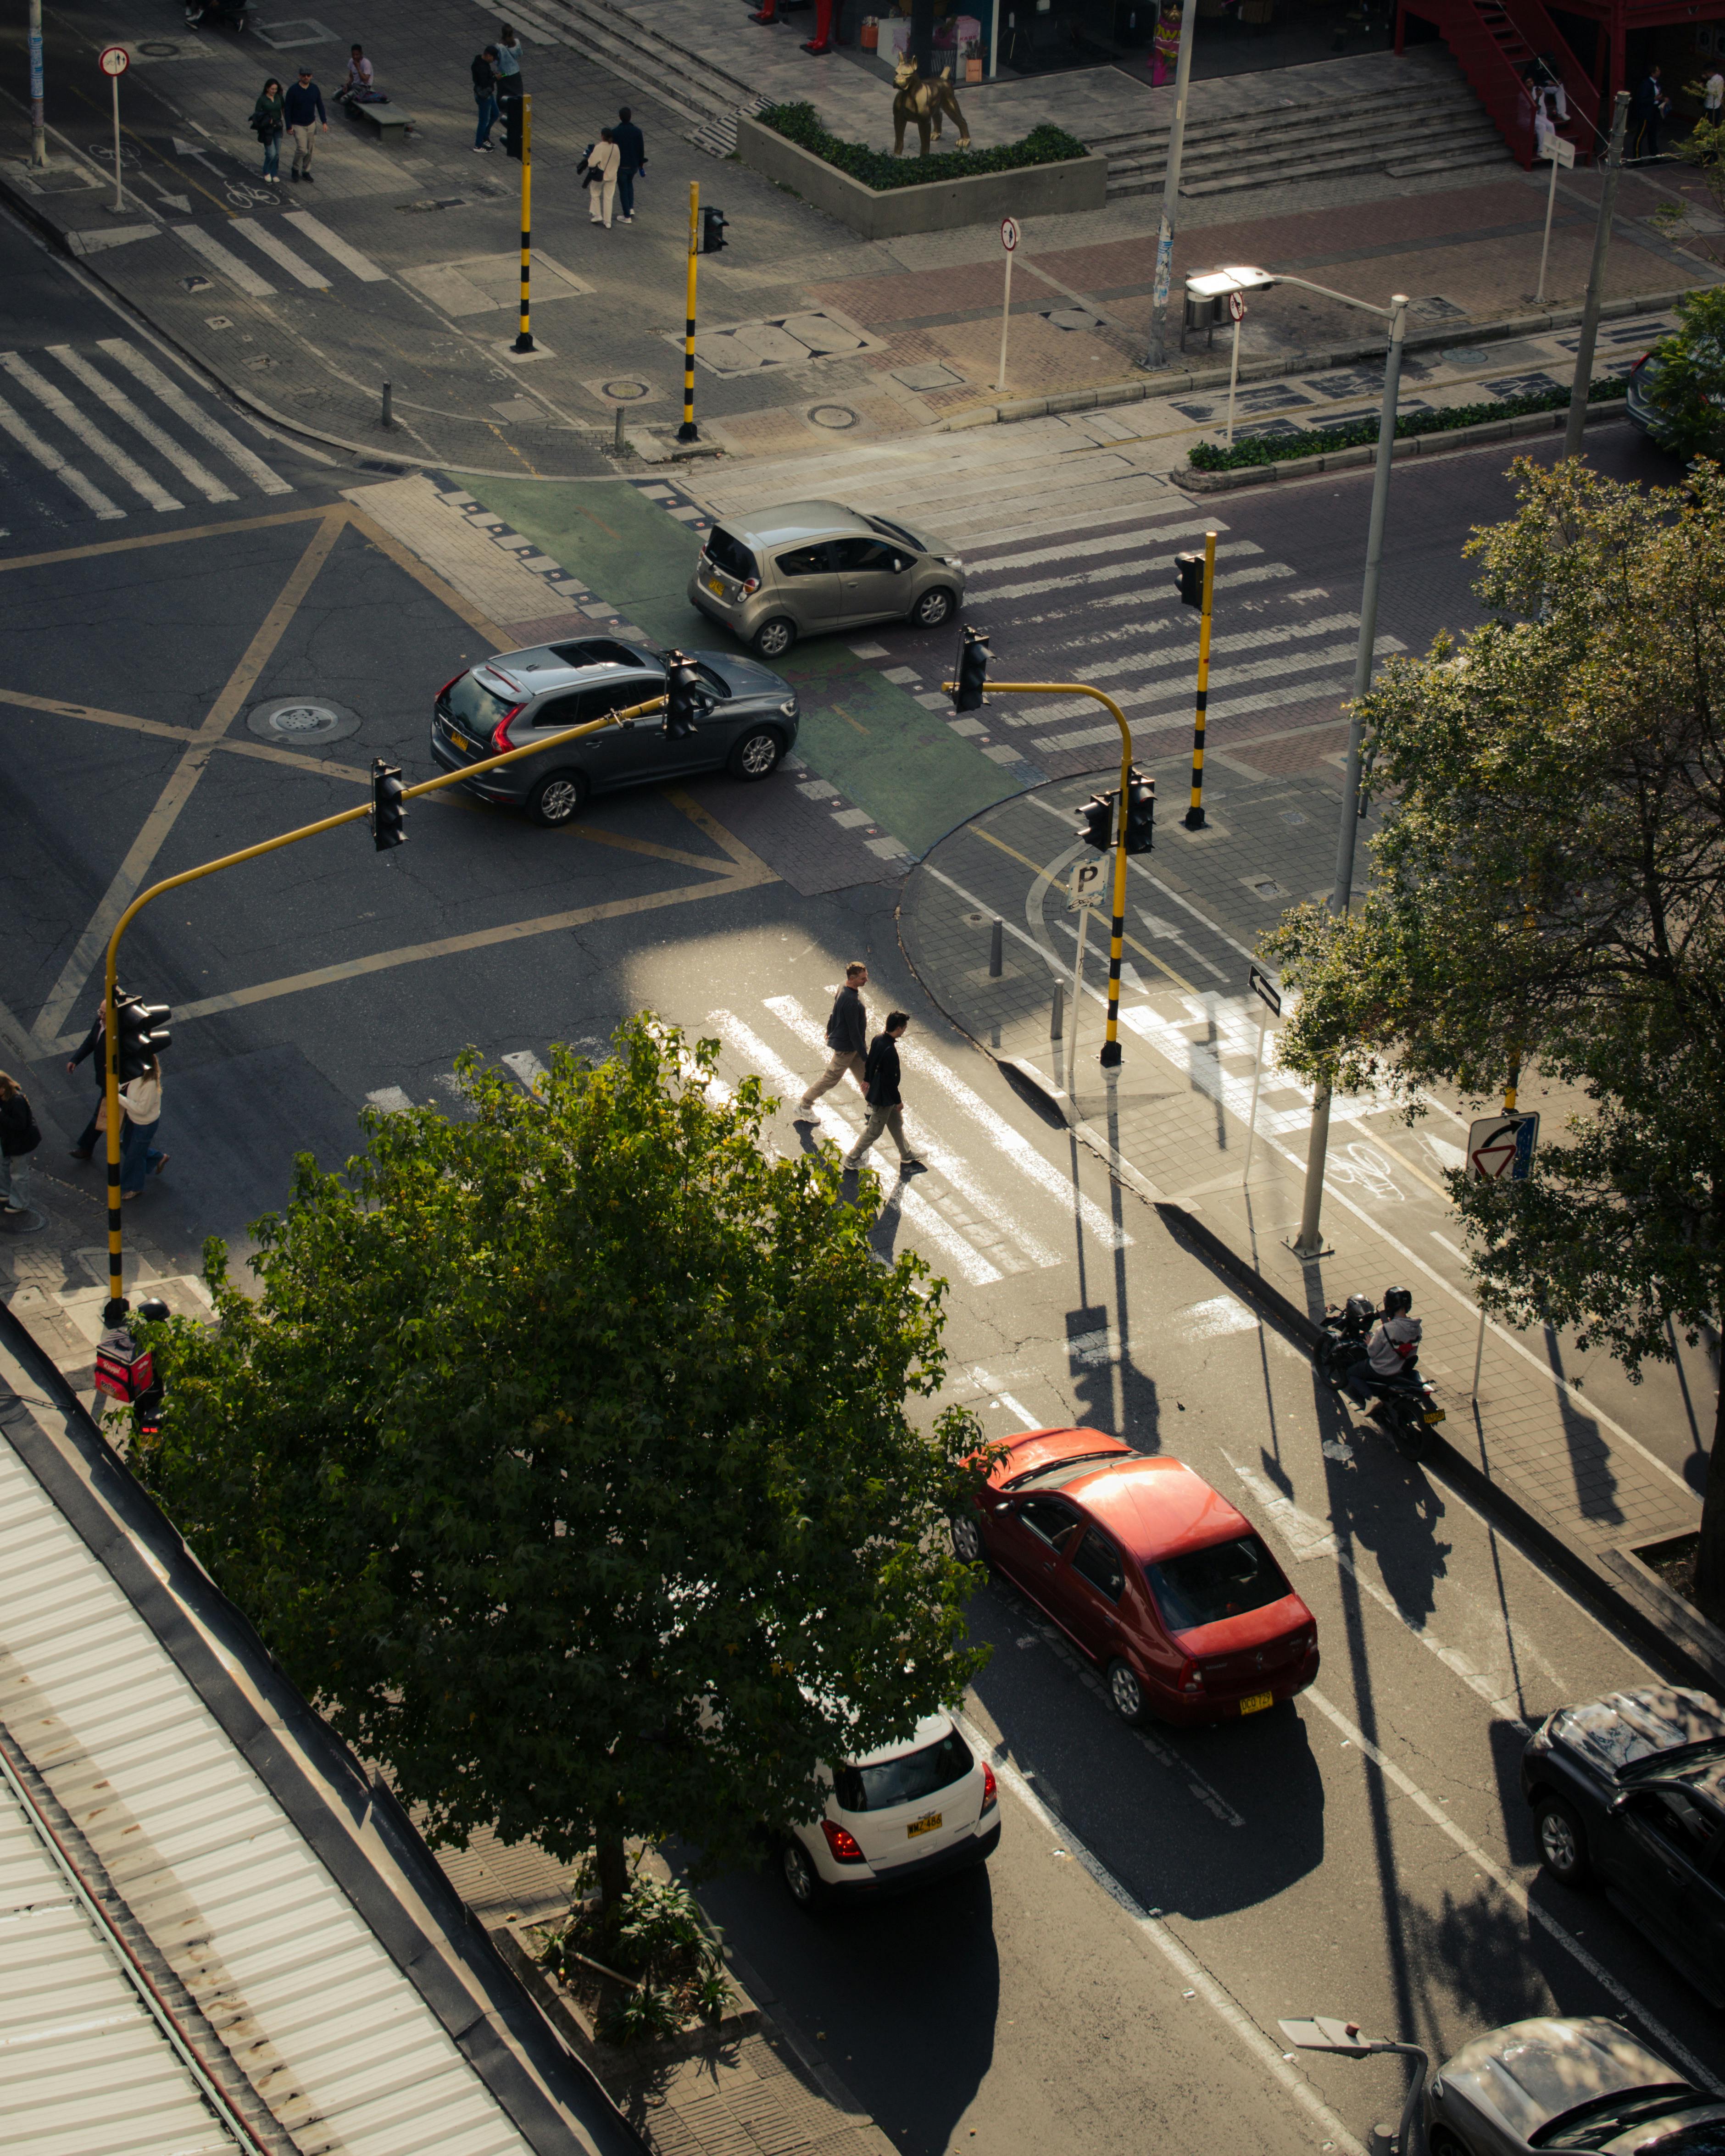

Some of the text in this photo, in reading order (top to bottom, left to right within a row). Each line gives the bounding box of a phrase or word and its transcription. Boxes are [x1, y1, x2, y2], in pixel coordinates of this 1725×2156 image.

[1078, 866, 1098, 892] P
[909, 1821, 924, 1834] WMZ
[926, 1814, 941, 1828] 486
